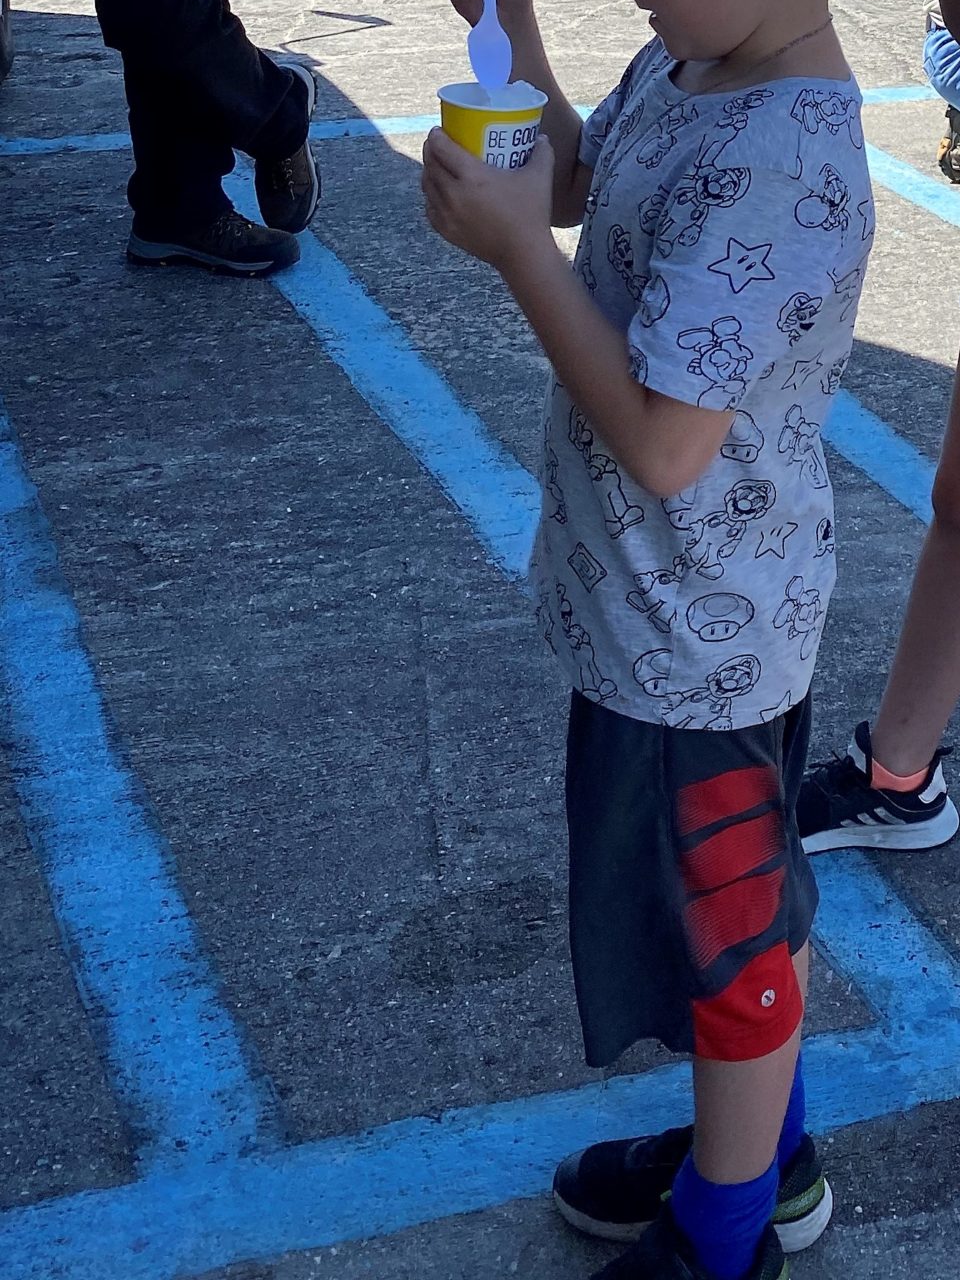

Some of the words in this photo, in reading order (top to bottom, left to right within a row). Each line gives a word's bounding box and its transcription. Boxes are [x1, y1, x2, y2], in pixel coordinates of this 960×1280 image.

[488, 130, 508, 149] BE
[512, 124, 540, 147] GOO
[509, 146, 534, 169] GO
